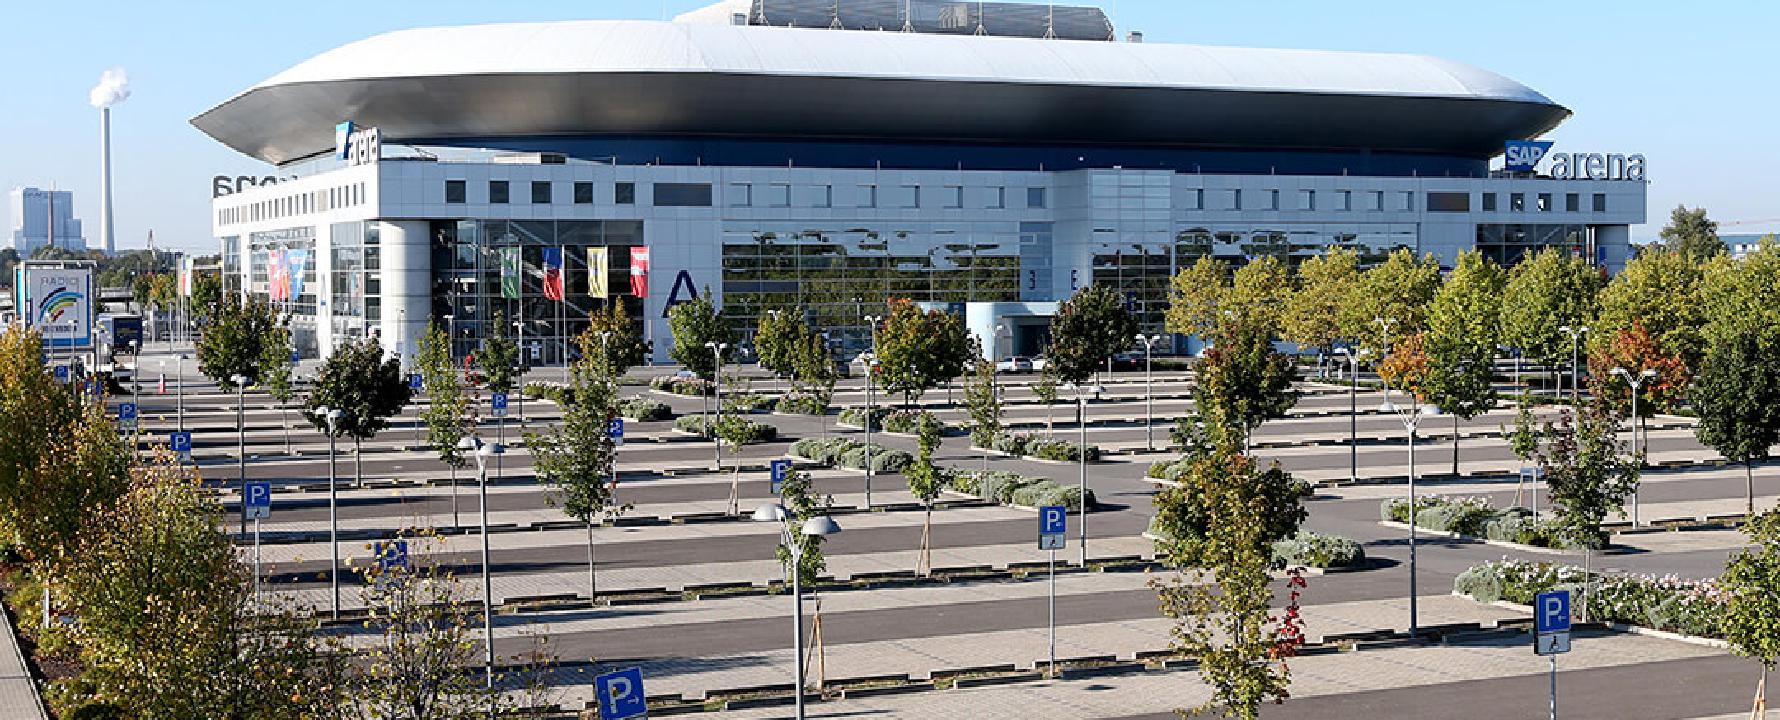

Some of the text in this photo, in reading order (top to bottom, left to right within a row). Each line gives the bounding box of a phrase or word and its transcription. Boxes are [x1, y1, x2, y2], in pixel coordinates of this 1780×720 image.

[1507, 145, 1646, 181] SAP arena
[661, 270, 703, 318] A
[175, 436, 186, 449] P
[251, 486, 264, 504] P
[1046, 510, 1059, 532] P
[1545, 598, 1562, 626] P
[605, 677, 632, 714] P
